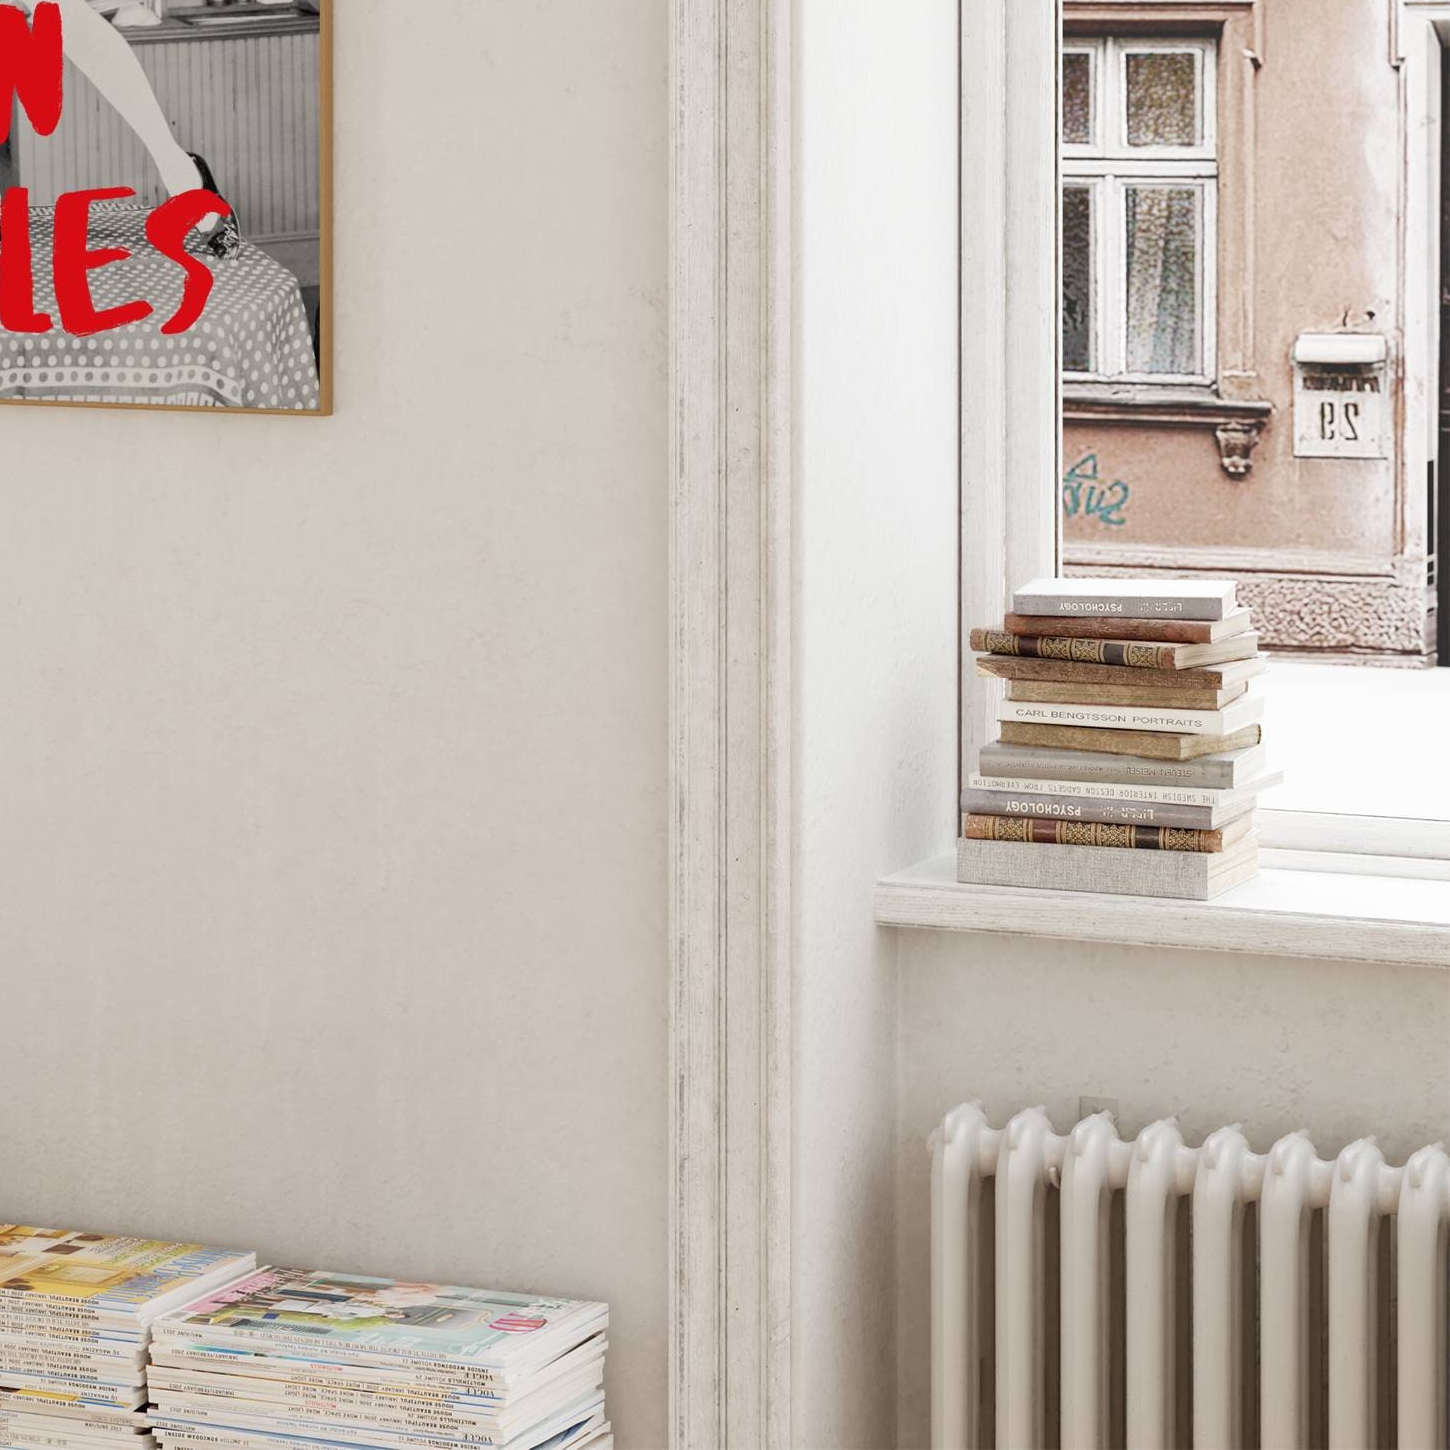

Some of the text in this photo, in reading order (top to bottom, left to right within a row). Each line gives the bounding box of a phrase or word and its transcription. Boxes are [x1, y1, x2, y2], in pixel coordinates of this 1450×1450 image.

[1059, 602, 1123, 612] PSYCHOLOGY
[1016, 708, 1203, 728] CARL BENGTSSON PORTRAITS
[973, 779, 1216, 804] THE SWEDISH INTERIOR DESIGN GADGETS FROM EVERMOTION
[1006, 801, 1081, 816] PSYCHOLOGY
